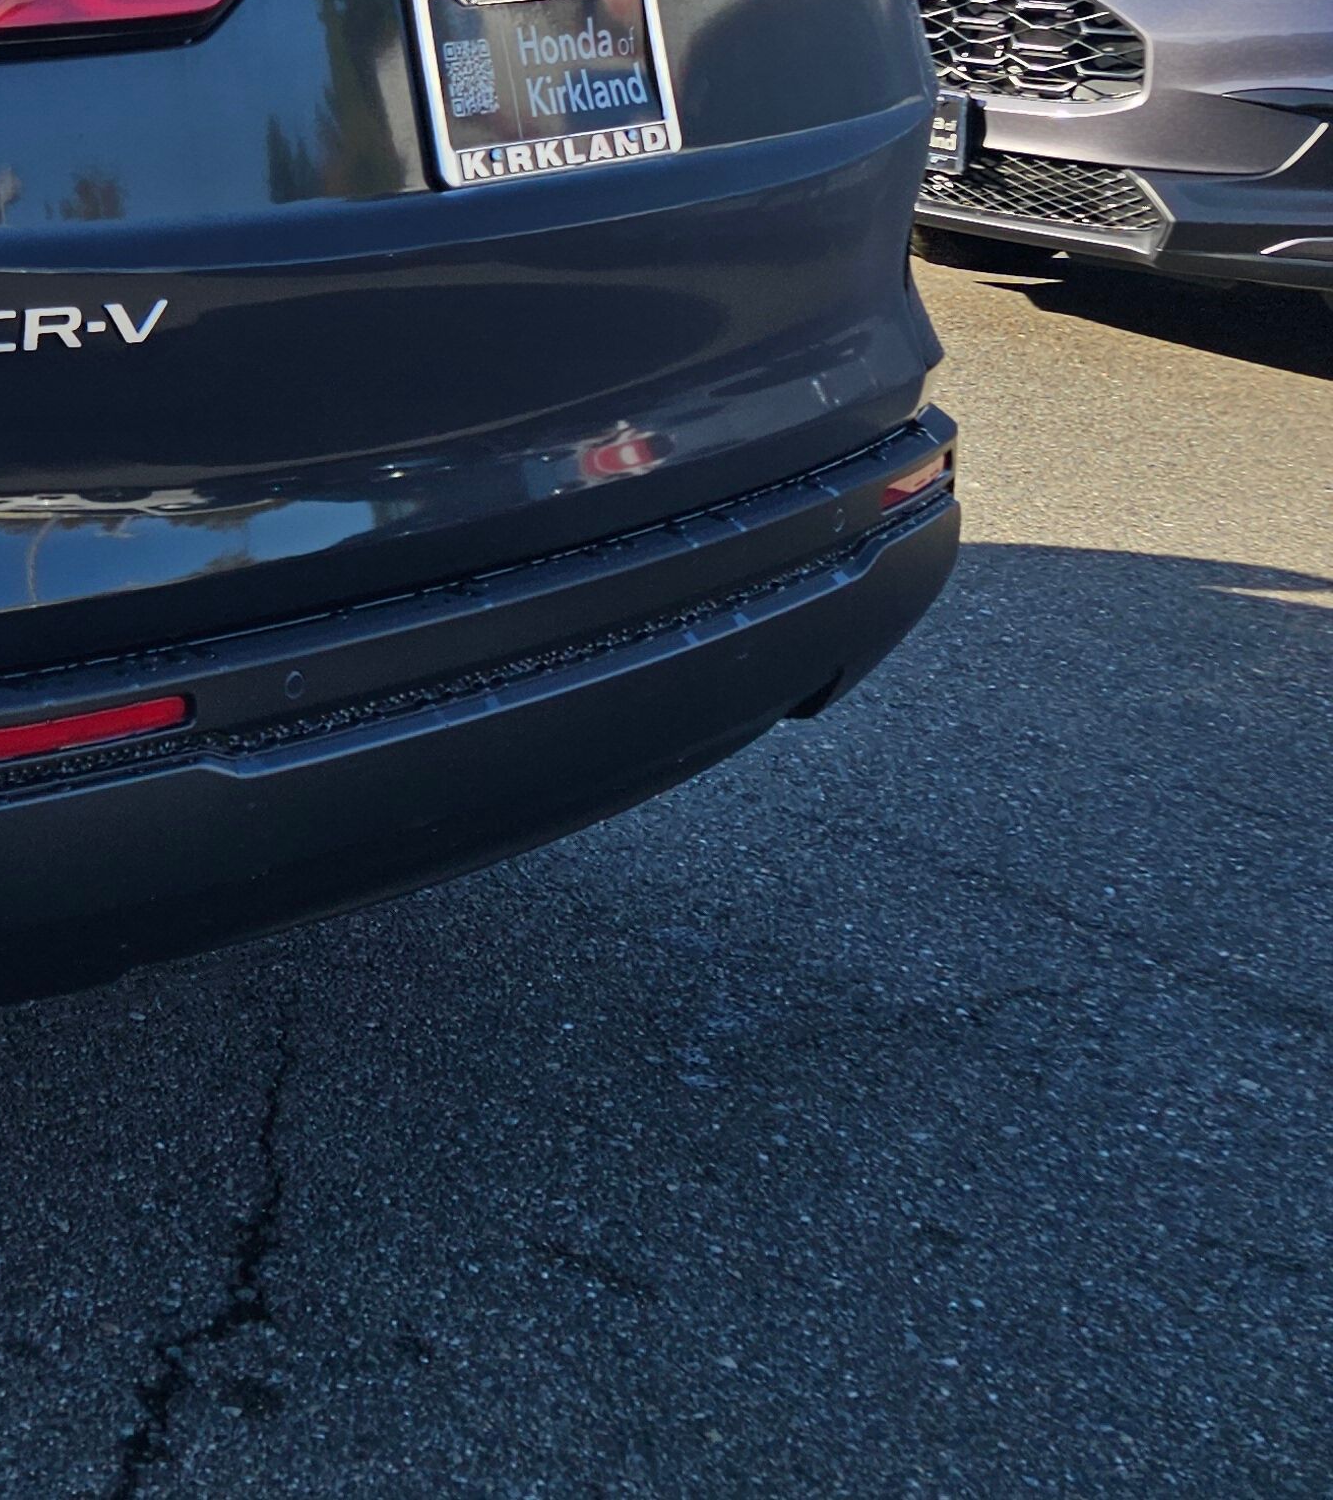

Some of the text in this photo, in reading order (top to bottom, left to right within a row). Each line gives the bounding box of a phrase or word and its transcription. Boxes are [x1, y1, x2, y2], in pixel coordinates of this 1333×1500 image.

[516, 17, 635, 67] Honda of
[524, 63, 648, 118] Kirkland
